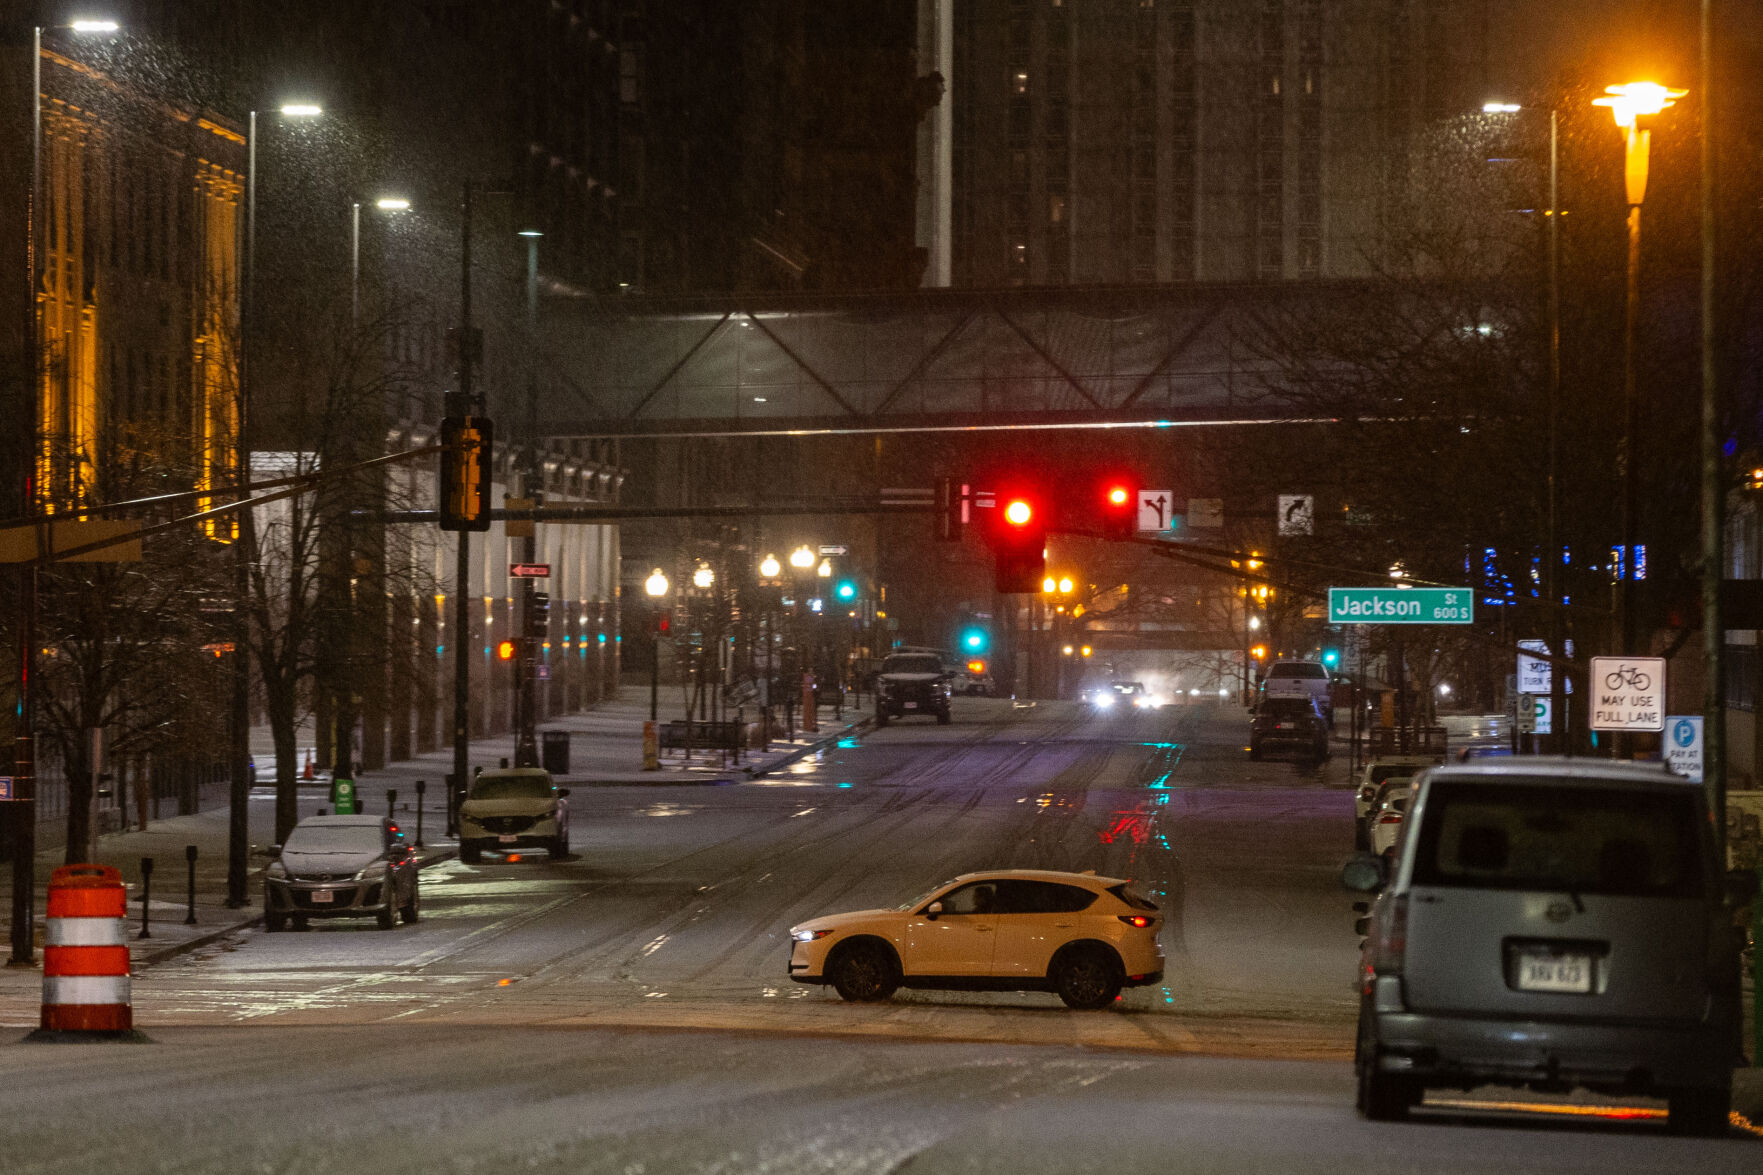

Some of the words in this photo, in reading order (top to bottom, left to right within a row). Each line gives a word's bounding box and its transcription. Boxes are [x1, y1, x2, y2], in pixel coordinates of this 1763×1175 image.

[1336, 595, 1421, 615] Jackson
[1445, 593, 1458, 605] St
[1434, 607, 1458, 619] 600
[1460, 607, 1469, 619] S
[1601, 696, 1625, 706] MAY
[1631, 696, 1654, 707] USE
[1596, 711, 1621, 722] FULL
[1628, 711, 1659, 723] LANE
[1679, 725, 1690, 743] P
[1670, 750, 1686, 758] PAY
[1688, 750, 1698, 758] AT
[1670, 762, 1701, 771] TATION
